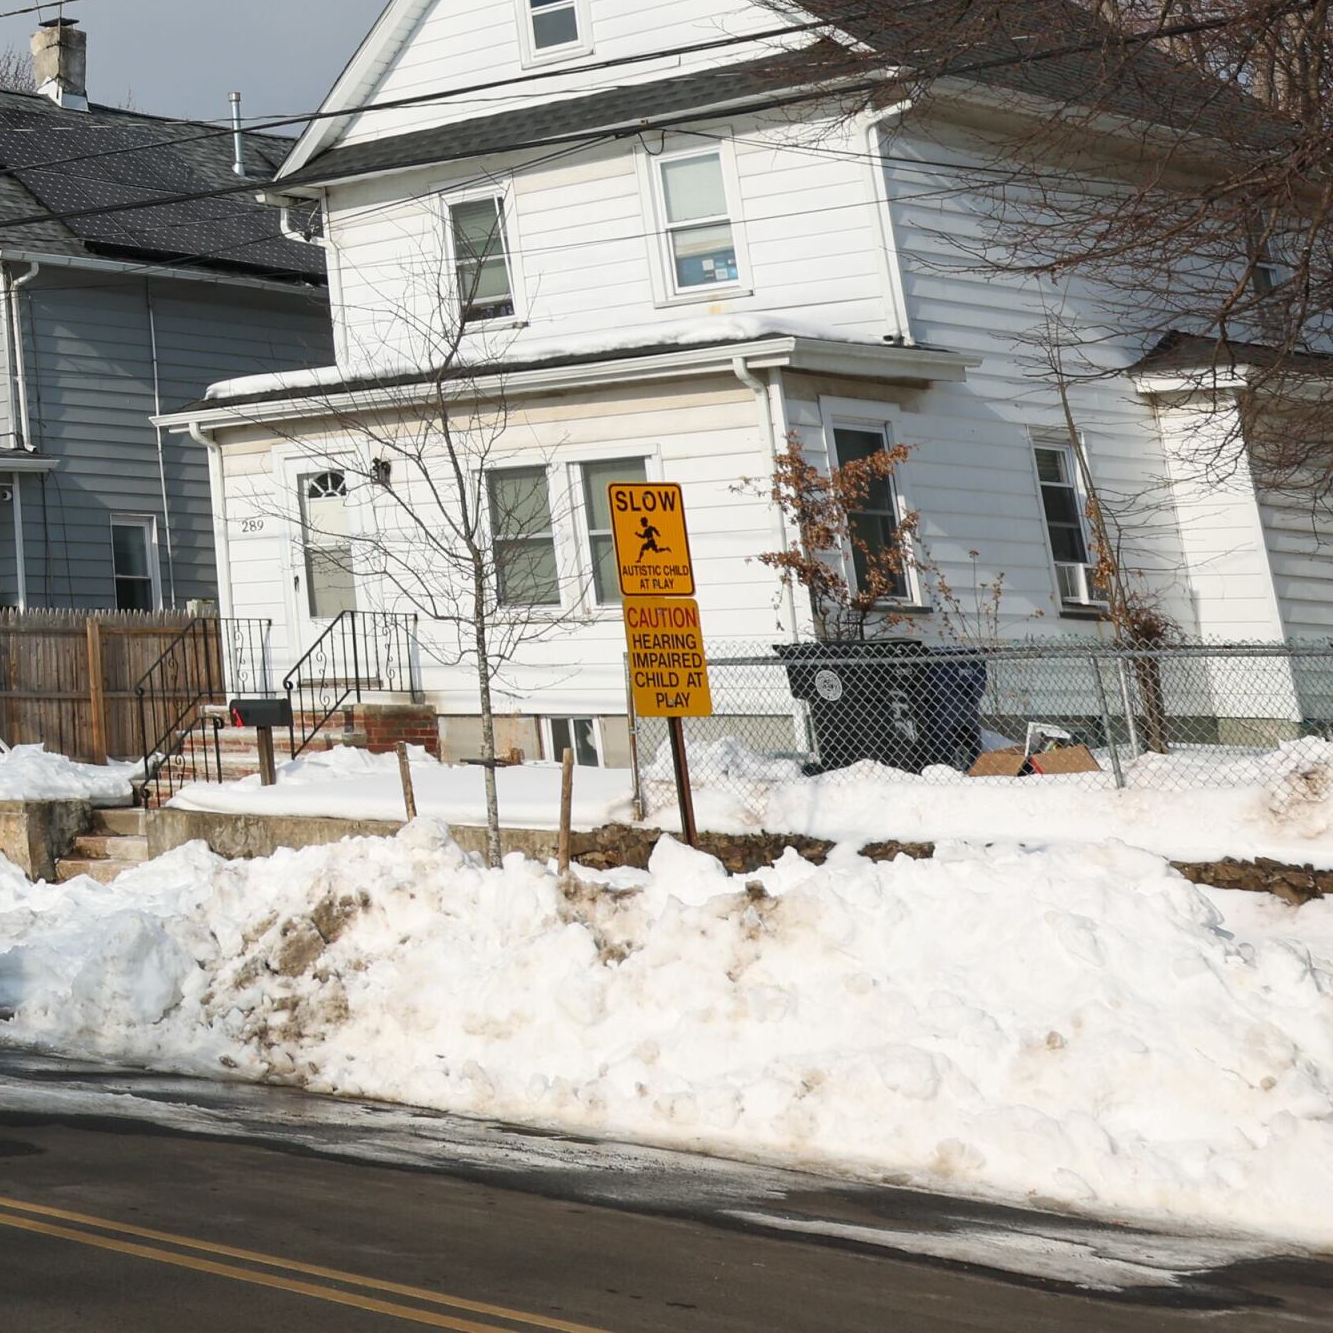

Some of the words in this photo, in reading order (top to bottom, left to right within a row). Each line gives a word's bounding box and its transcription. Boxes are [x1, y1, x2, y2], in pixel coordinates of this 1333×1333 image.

[615, 490, 676, 512] SLOW
[241, 519, 264, 533] 289
[622, 565, 662, 576] AUTISTIC
[663, 565, 689, 577] CHILD
[639, 579, 652, 590] AT
[653, 578, 674, 590] PLAY
[626, 606, 698, 629] CAUTION
[632, 633, 697, 650] HEARING
[632, 652, 703, 668] IMPAIRED
[634, 671, 680, 688] CHILD
[685, 672, 704, 688] AT
[655, 691, 691, 709] PLAY
